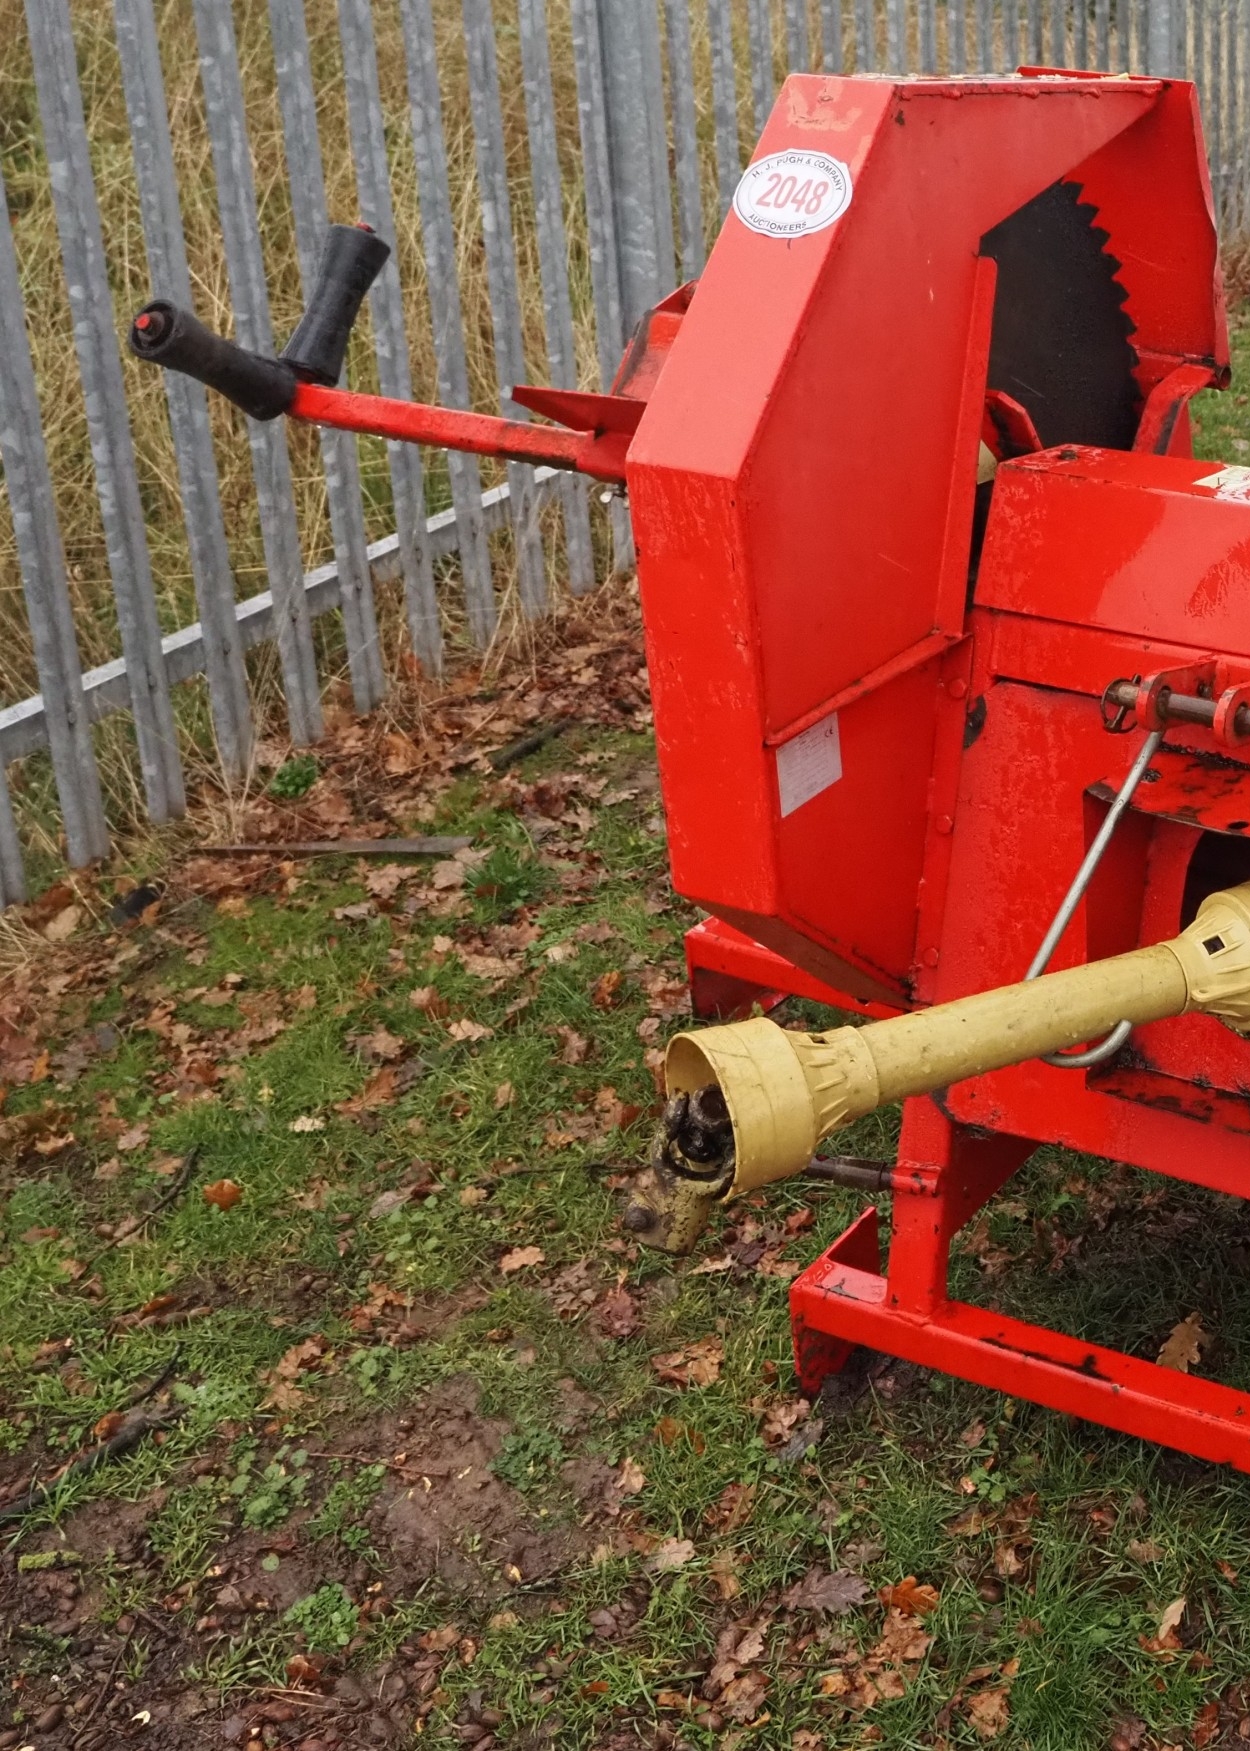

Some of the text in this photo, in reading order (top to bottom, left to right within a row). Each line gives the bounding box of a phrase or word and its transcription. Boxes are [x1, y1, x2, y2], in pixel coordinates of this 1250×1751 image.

[777, 156, 803, 166] PUGH
[806, 157, 811, 165] &
[814, 159, 842, 191] COMPANY
[756, 172, 829, 215] 2048
[748, 213, 807, 231] AUCTIONEERS
